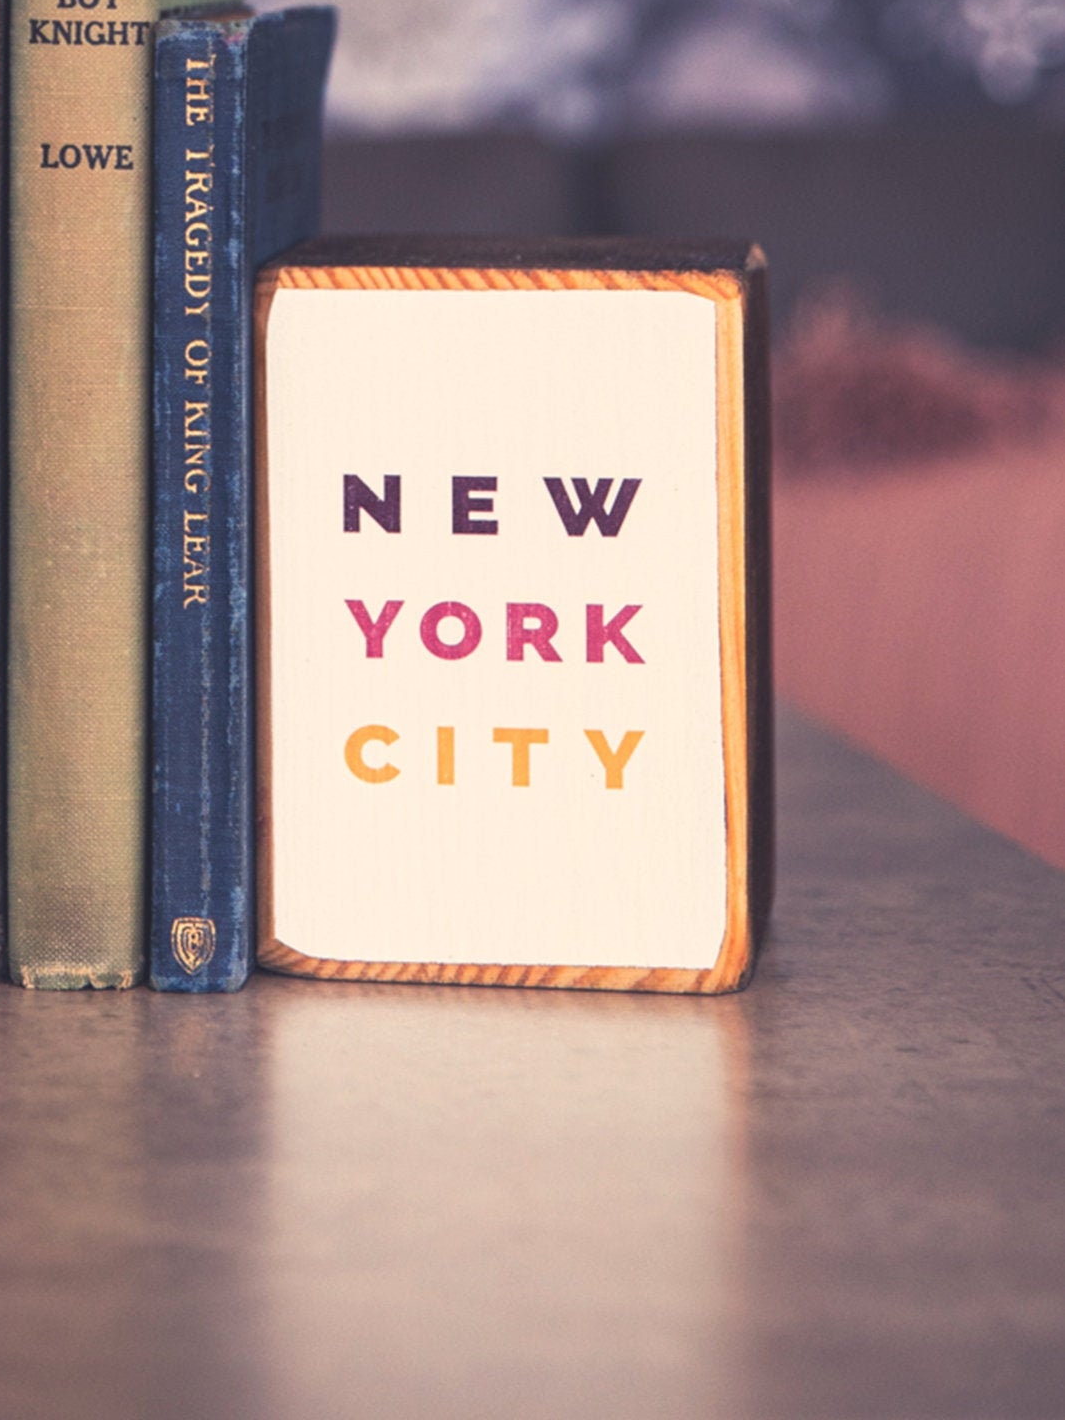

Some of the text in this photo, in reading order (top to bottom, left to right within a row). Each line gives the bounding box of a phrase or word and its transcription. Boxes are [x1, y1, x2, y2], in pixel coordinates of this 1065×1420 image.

[29, 20, 150, 47] KNIGHT
[40, 144, 134, 170] LOWE
[183, 53, 217, 610] THE TRAGEDY OF KING LEAR
[343, 474, 643, 537] NEW
[344, 599, 646, 664] YORK
[343, 724, 646, 790] CITY
